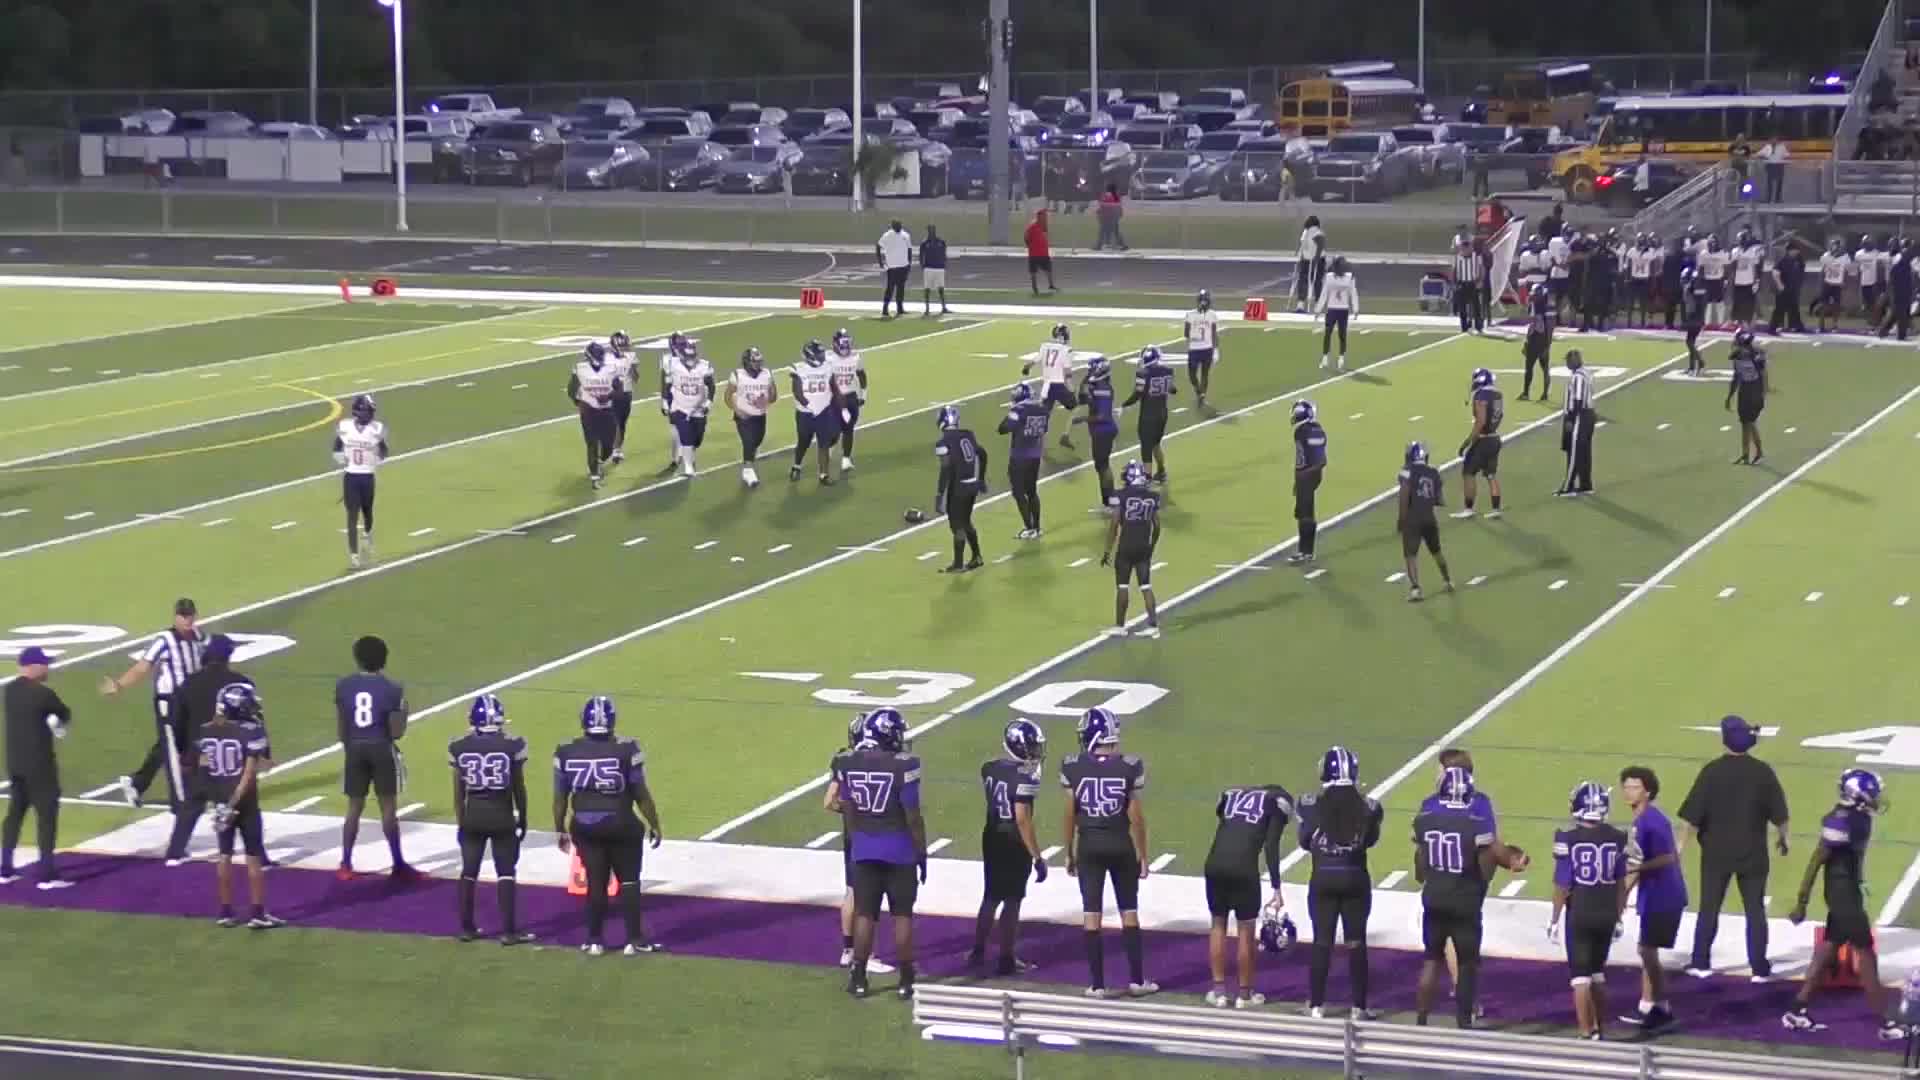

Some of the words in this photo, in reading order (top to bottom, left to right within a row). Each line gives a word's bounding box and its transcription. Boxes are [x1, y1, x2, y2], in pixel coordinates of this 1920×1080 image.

[802, 289, 818, 306] 10
[1246, 301, 1260, 319] 20
[1044, 349, 1059, 370] 17
[960, 438, 976, 463] 0
[355, 692, 373, 728] 8
[199, 738, 243, 777] 30
[459, 753, 511, 790] 33
[565, 758, 624, 794] 75
[847, 771, 894, 813] 57
[1075, 777, 1126, 817] 45
[1223, 789, 1265, 823] 14
[1424, 830, 1463, 873] 11
